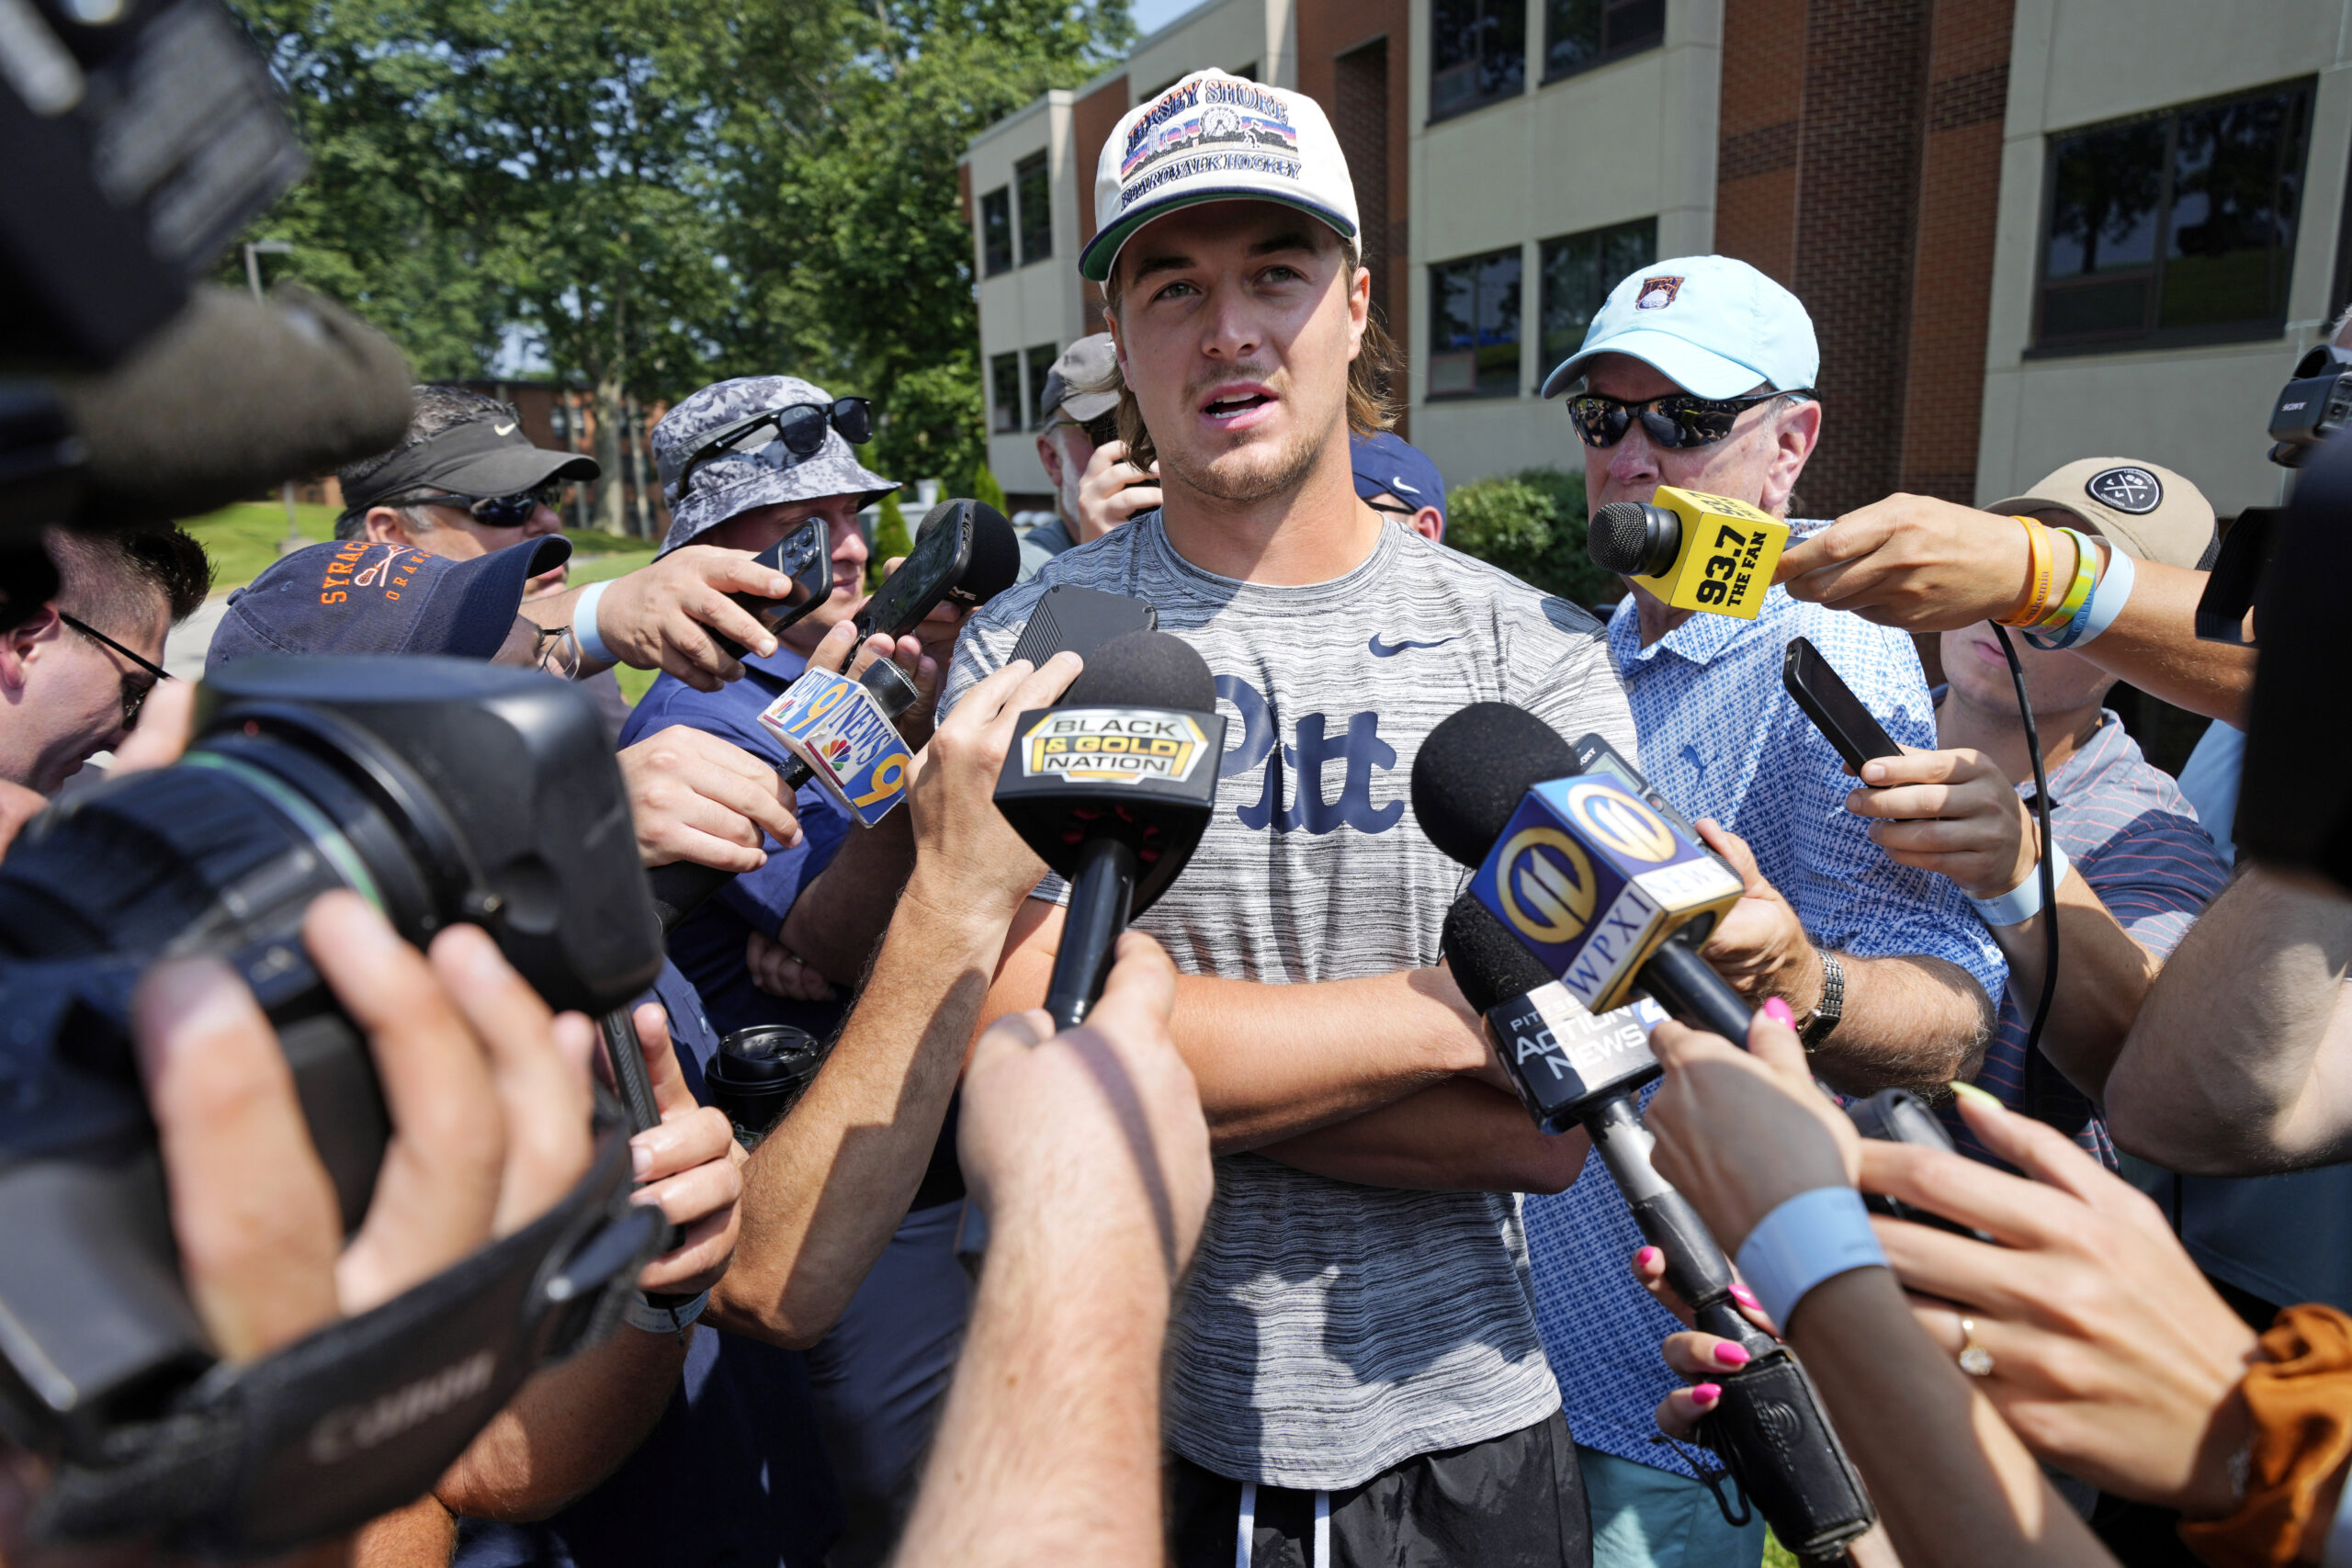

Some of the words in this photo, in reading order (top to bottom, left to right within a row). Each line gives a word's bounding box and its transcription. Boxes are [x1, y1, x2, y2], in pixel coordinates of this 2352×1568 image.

[1126, 79, 1202, 153] JERSEY
[1205, 80, 1289, 123] SHORE
[1120, 154, 1224, 212] BOARDWALK
[1223, 153, 1301, 180] HOCKEY
[2281, 401, 2307, 412] SONY
[321, 541, 373, 605] SYRAC
[1696, 525, 1747, 605] 93.7
[1726, 572, 1751, 607] THE
[1742, 531, 1768, 570] FAN
[788, 682, 849, 733] 9
[828, 694, 893, 766] NEWS
[1053, 719, 1177, 736] BLACK
[1045, 738, 1068, 753] &
[1074, 736, 1180, 757] GOLD
[1047, 756, 1167, 772] NATION
[853, 753, 912, 808] 9
[1565, 890, 1652, 996] WPXI
[1510, 997, 1581, 1032] PITTSB
[1544, 1023, 1647, 1080] NEWS
